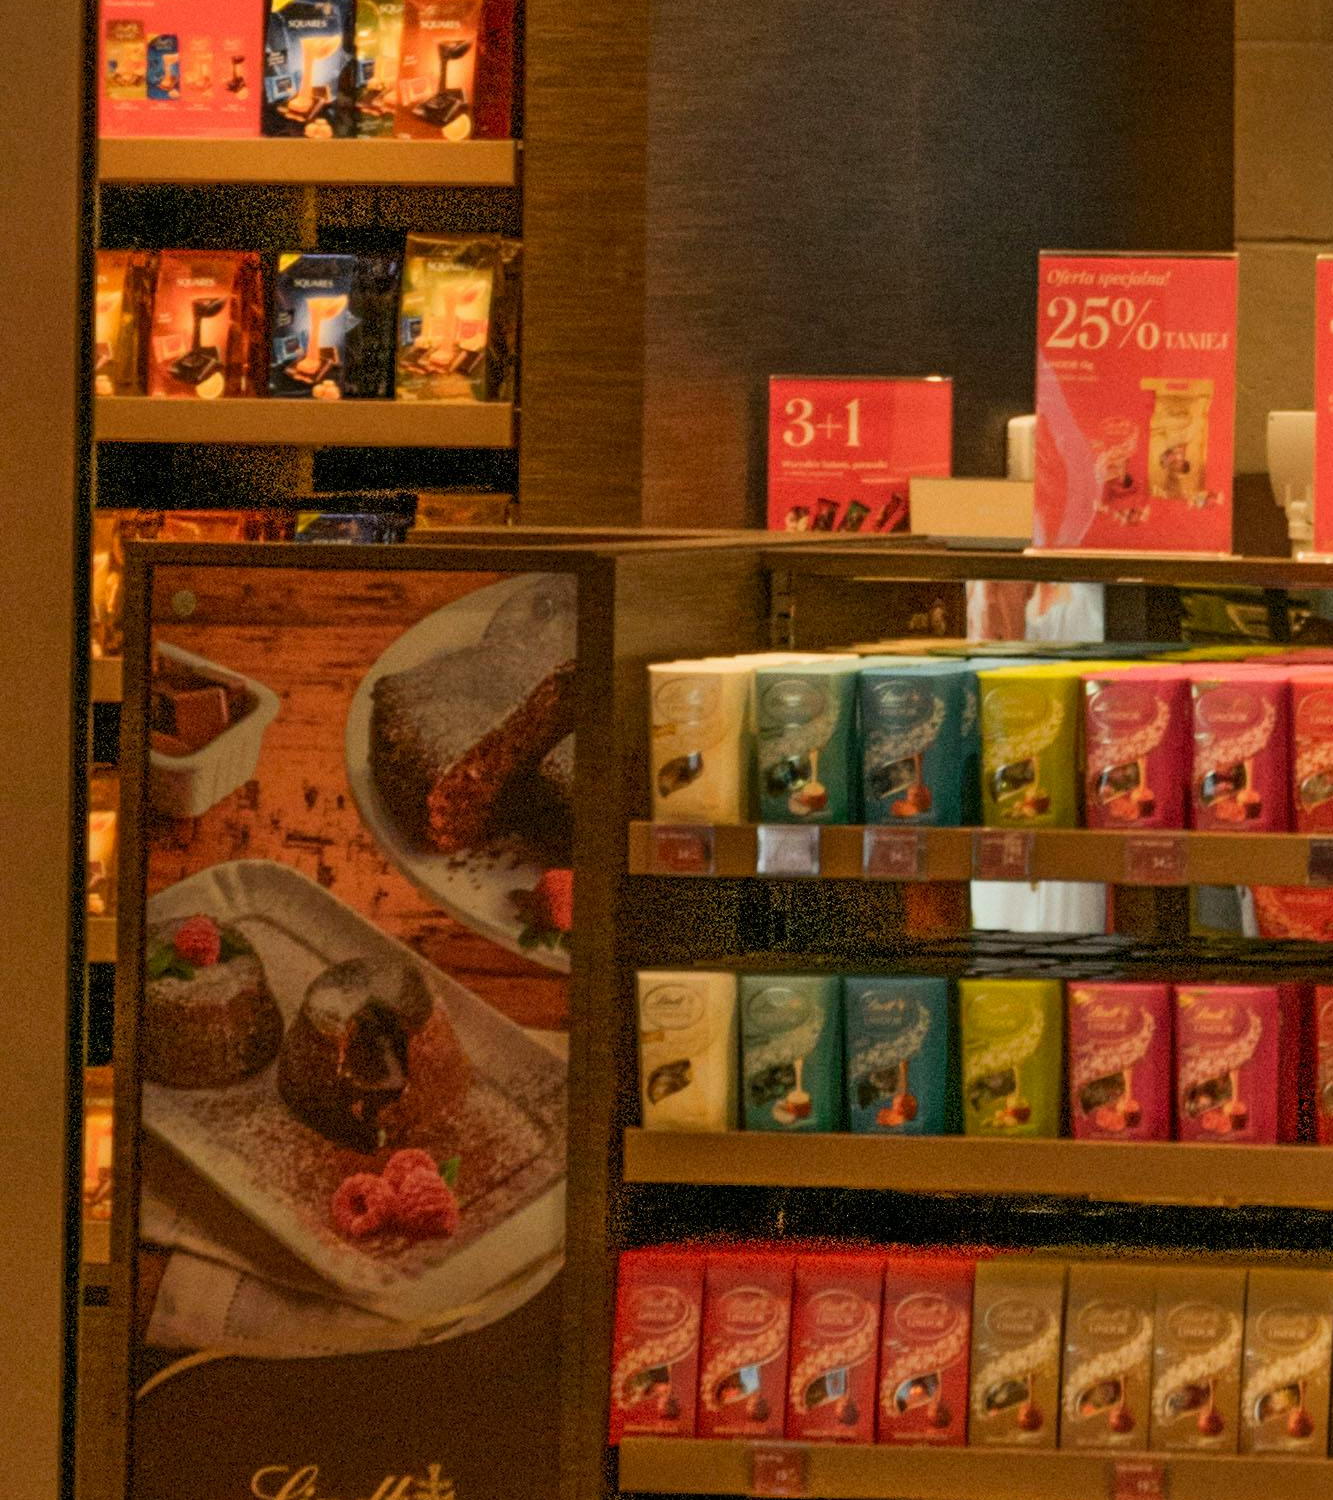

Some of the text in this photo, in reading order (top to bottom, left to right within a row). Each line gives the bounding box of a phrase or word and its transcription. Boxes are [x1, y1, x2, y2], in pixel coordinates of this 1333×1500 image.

[1046, 268, 1094, 287] Oferta
[1045, 295, 1229, 351] 25% TANIEJ
